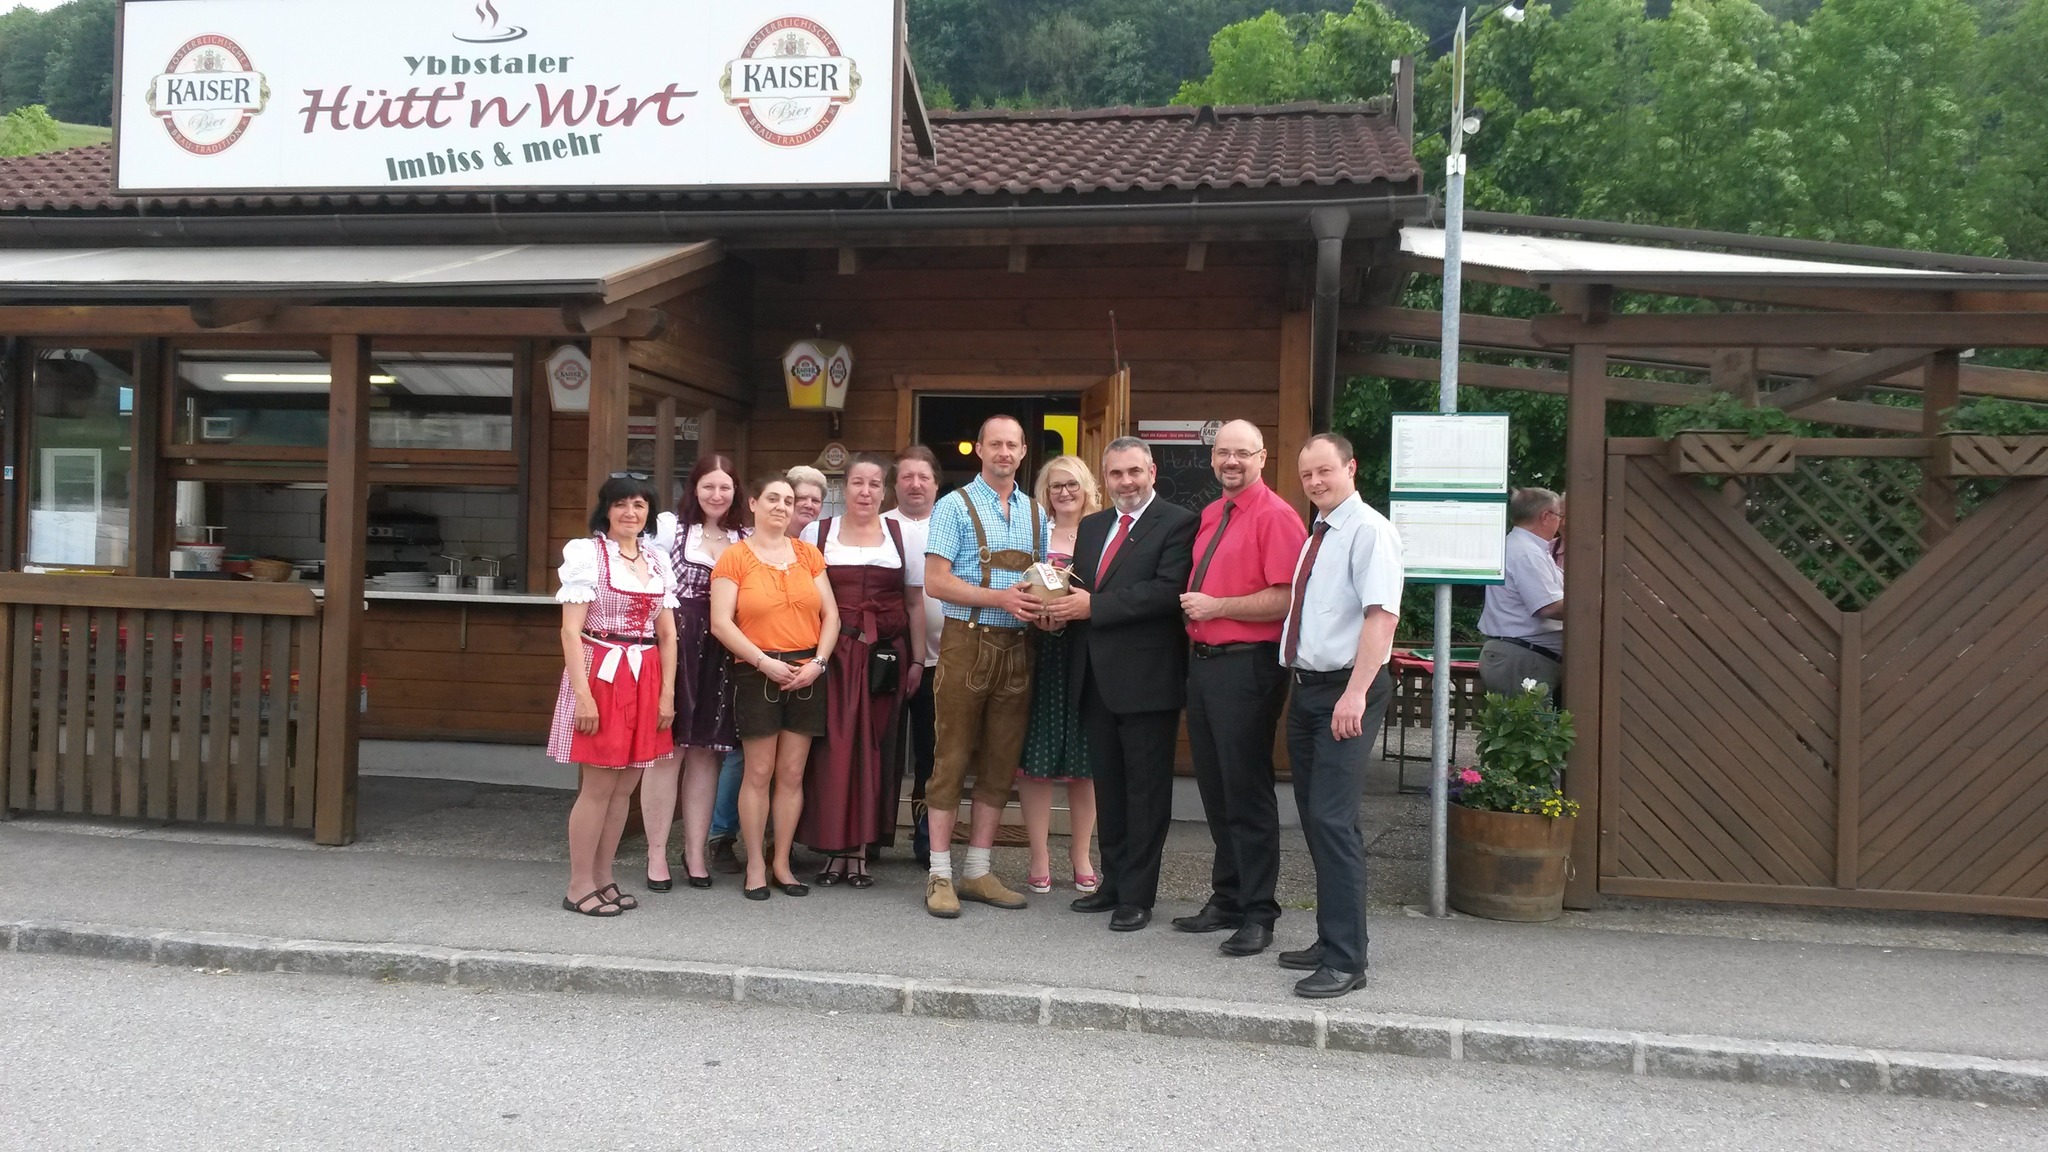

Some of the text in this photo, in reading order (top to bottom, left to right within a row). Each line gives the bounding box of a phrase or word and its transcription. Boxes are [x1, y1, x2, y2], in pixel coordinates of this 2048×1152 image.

[403, 53, 574, 76] Ybbstaler
[743, 63, 839, 93] KAISER
[166, 78, 251, 105] KAISER
[535, 83, 698, 128] Wirt
[768, 101, 811, 125] Bier
[187, 113, 226, 135] Bier
[386, 132, 603, 181] Imbiss & mehr
[1162, 449, 1210, 469] Heute
